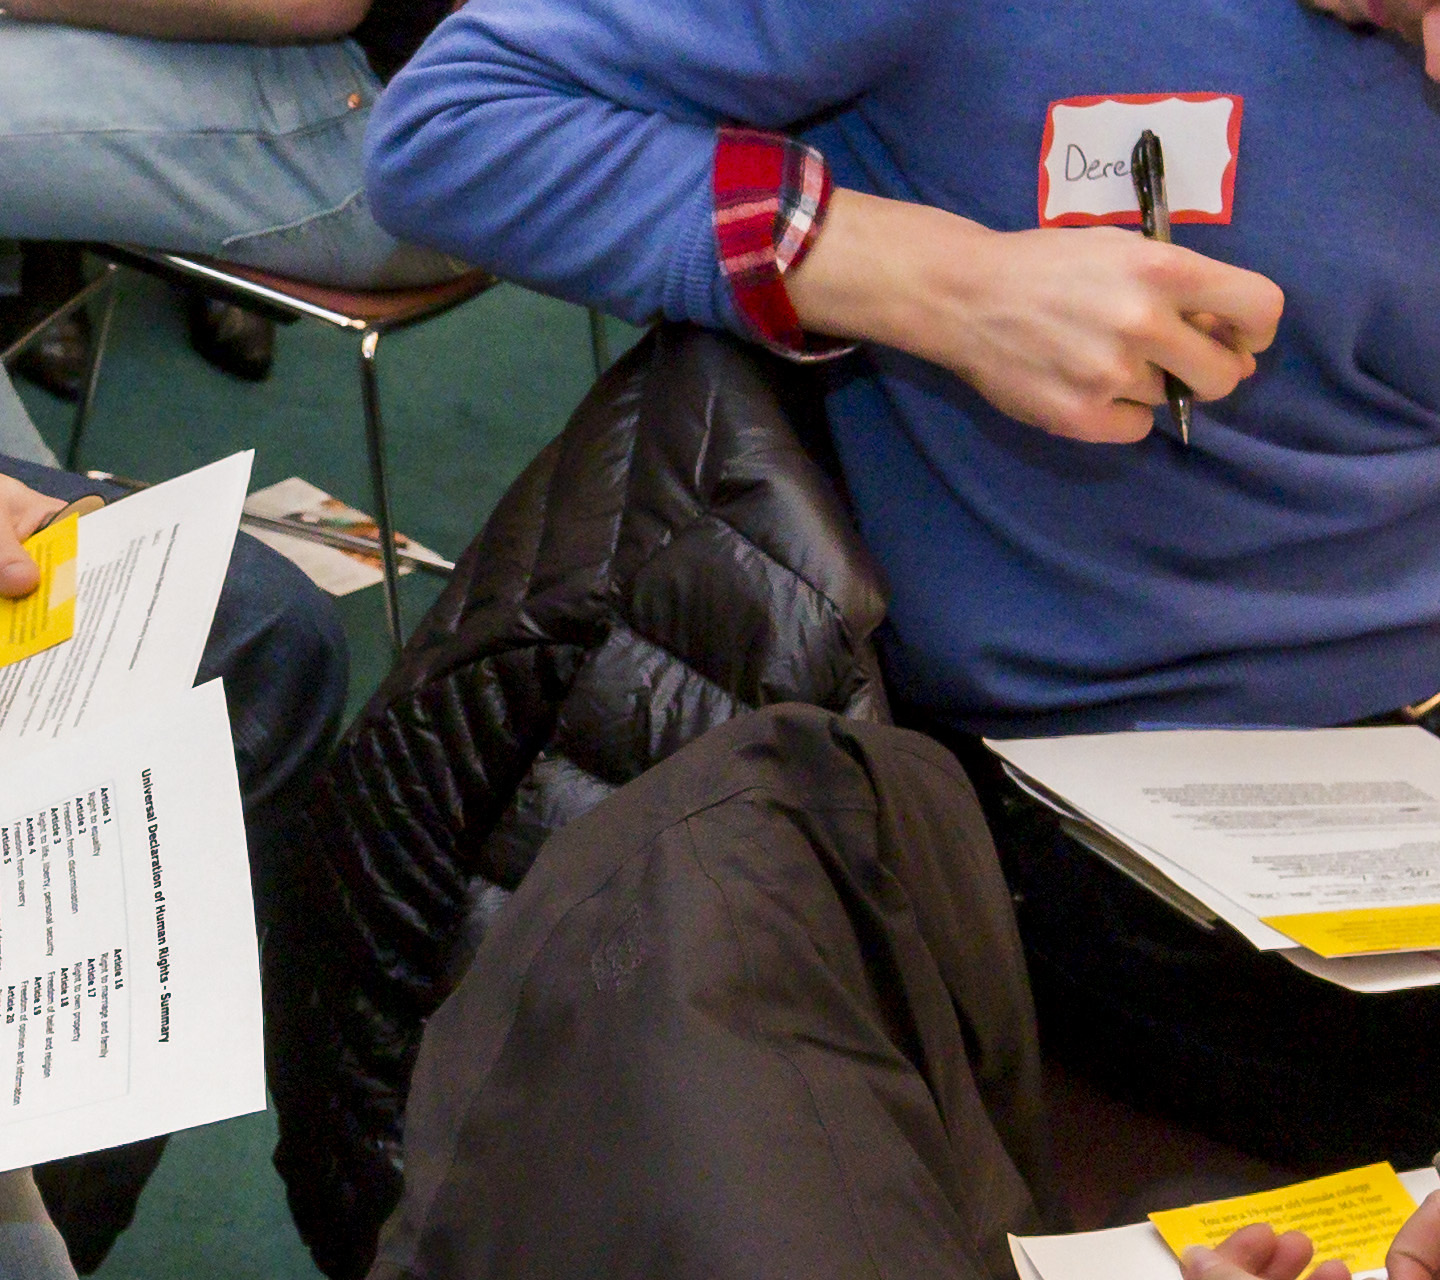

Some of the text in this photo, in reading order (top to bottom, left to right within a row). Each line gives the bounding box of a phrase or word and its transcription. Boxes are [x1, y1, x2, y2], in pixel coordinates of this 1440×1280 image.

[1065, 143, 1133, 182] Dere
[100, 786, 111, 816] Article
[141, 767, 157, 822] Universal
[25, 816, 37, 855] Article 4
[51, 806, 61, 845] Article 3
[75, 796, 87, 835] Article 2
[0, 826, 12, 865] Article 5
[146, 822, 163, 889] Declaration
[153, 889, 166, 903] of
[154, 903, 166, 946] Human
[86, 957, 96, 997] Article 17
[113, 947, 123, 990] Article 16
[156, 945, 170, 984] Rights
[5, 984, 16, 1024] Article 20
[32, 975, 42, 1016] Article 19
[59, 966, 69, 1008] Article 18
[157, 991, 171, 1043] Summary
